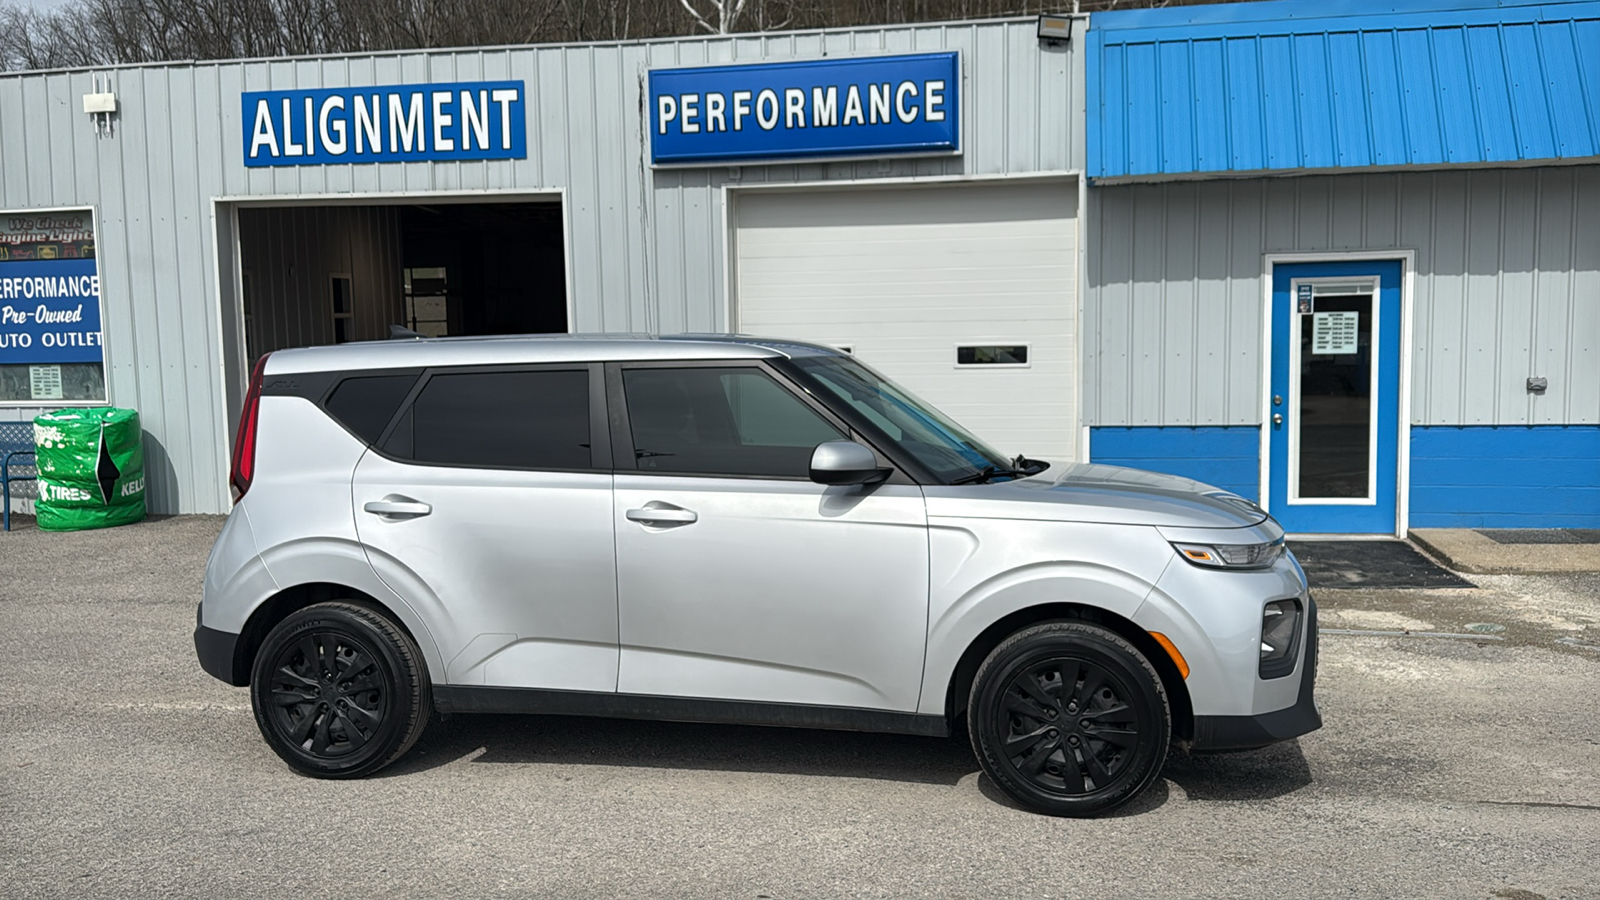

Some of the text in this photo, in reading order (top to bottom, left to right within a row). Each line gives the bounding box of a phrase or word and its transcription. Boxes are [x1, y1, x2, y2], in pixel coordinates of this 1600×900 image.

[657, 79, 946, 134] PERFORMANCE
[249, 88, 519, 158] ALIGNMENT
[8, 217, 83, 231] We Check
[2, 304, 83, 325] Pre-Owned
[41, 332, 102, 347] OUTLET
[49, 485, 92, 501] TIRES
